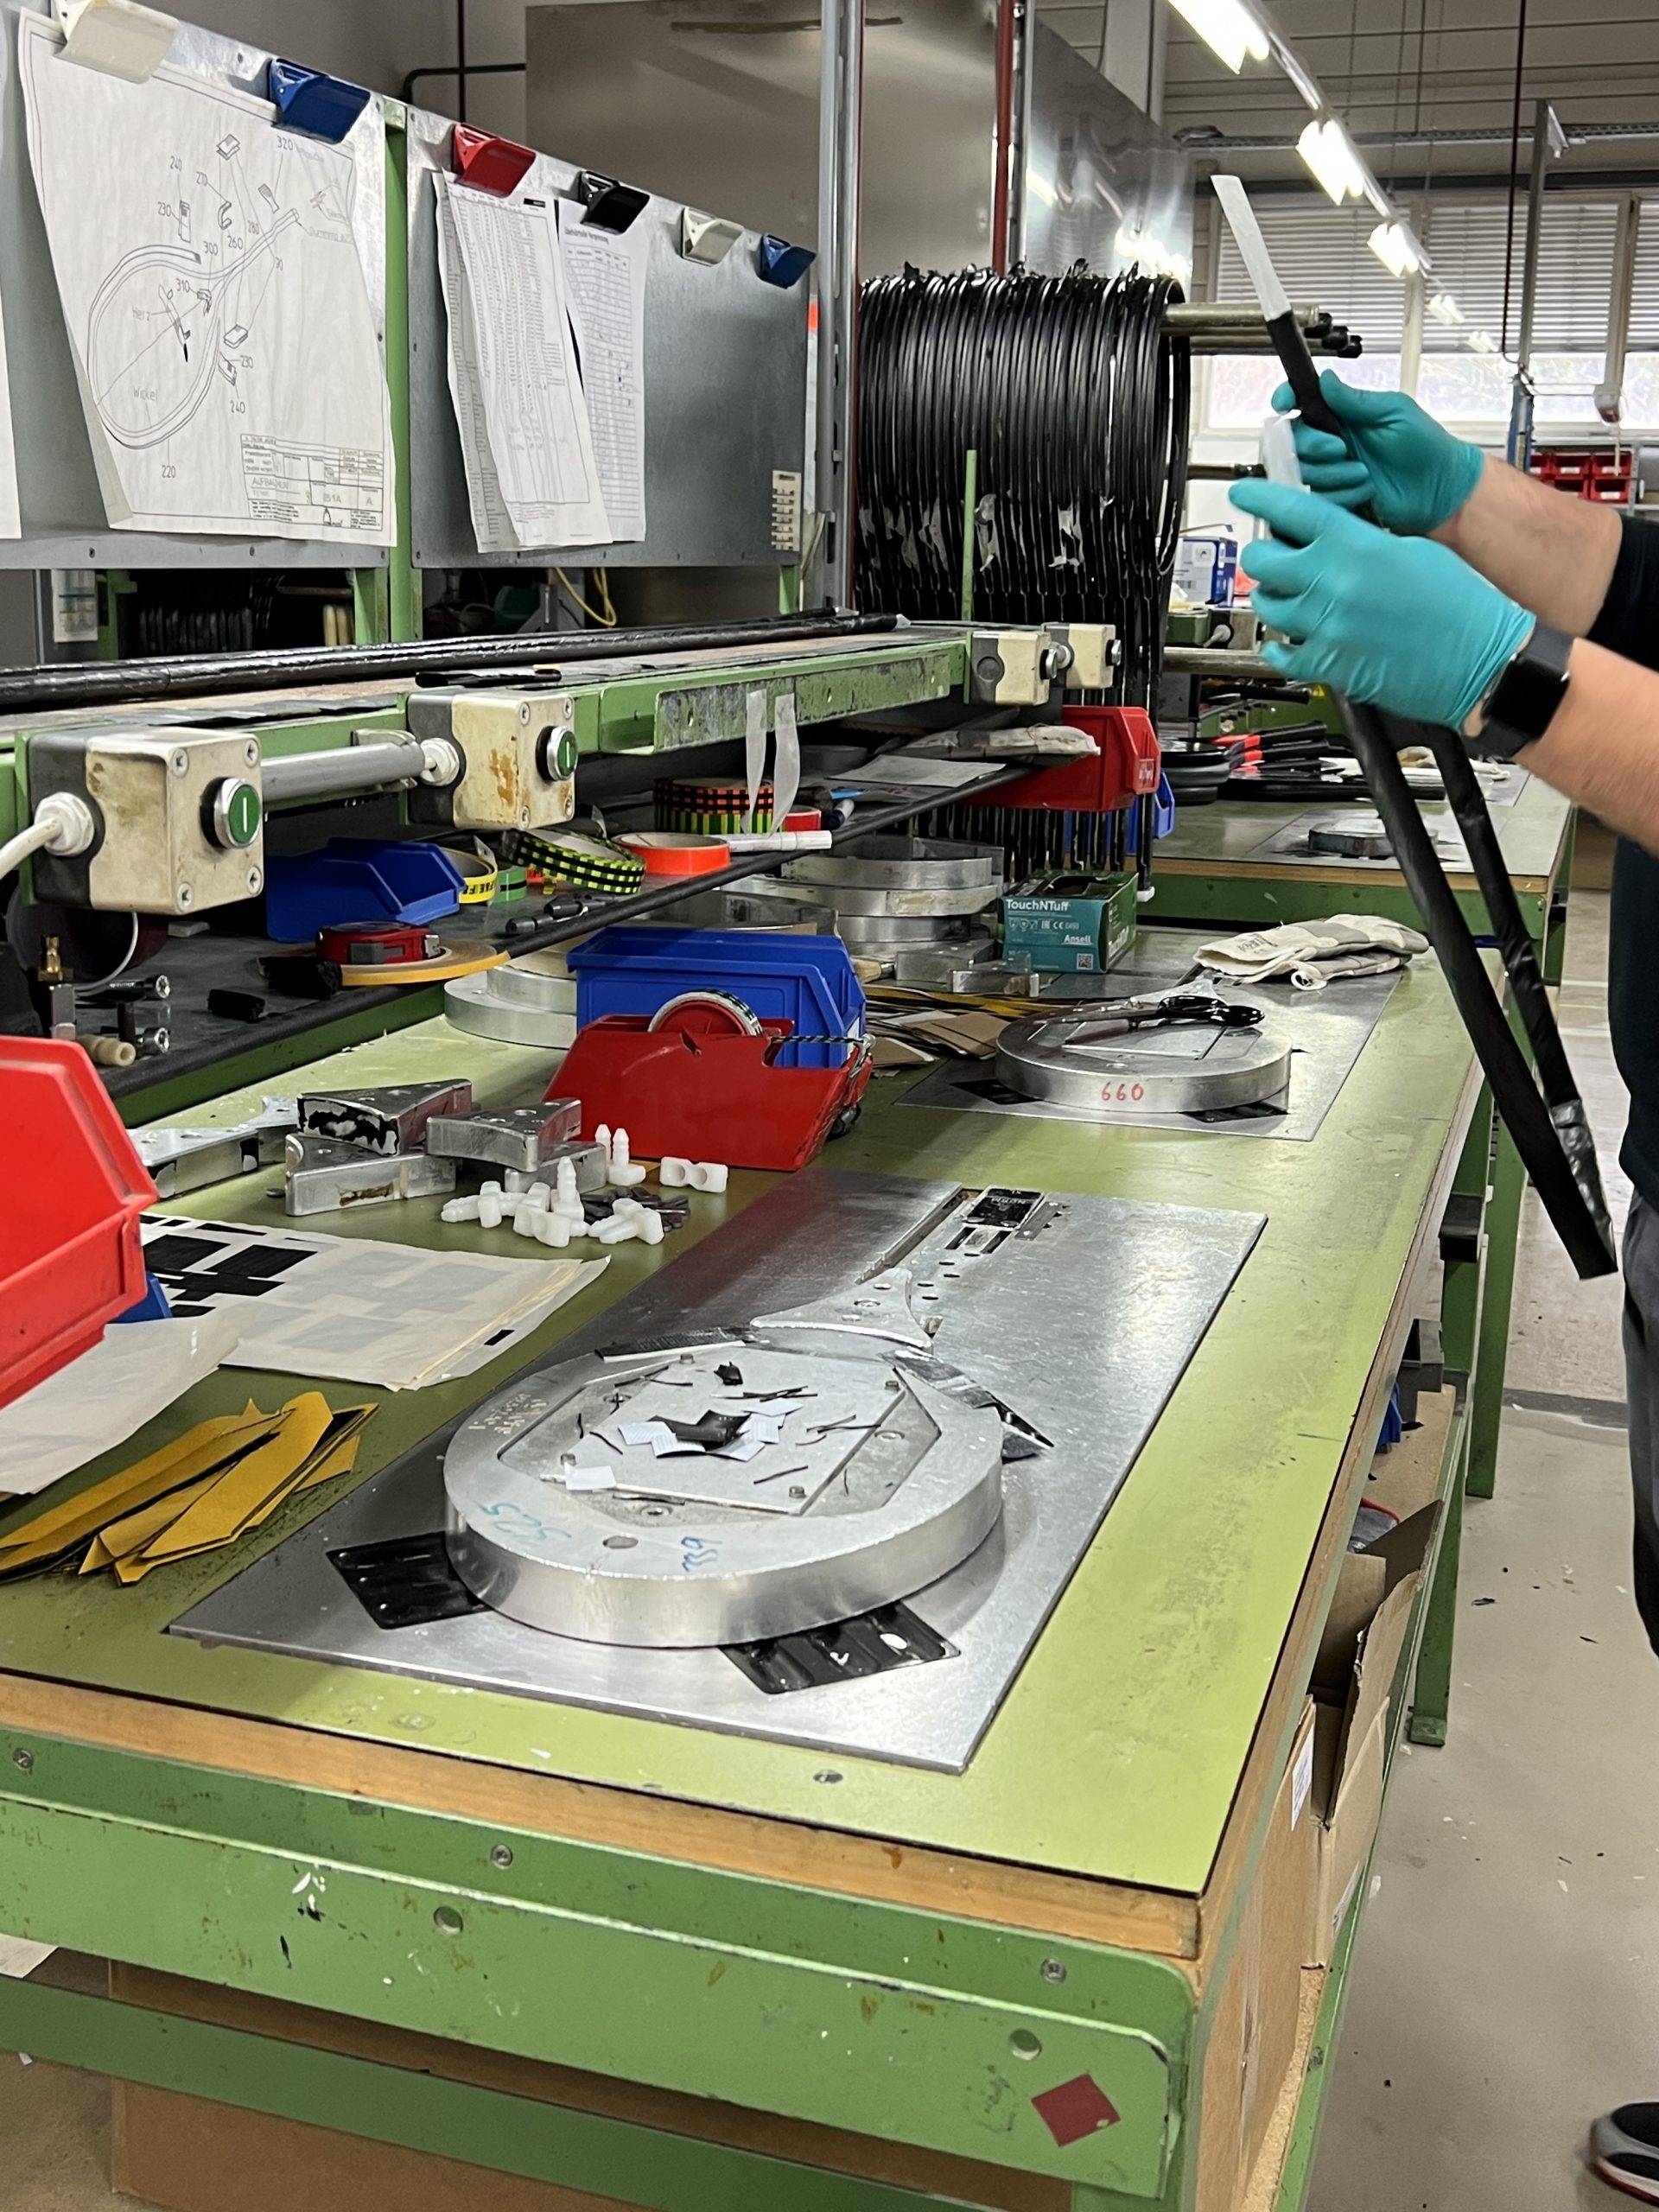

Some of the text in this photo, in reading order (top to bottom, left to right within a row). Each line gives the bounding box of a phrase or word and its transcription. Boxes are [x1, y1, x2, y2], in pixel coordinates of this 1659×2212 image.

[276, 136, 294, 151] 320
[169, 156, 182, 172] 240
[157, 201, 172, 217] 230
[204, 240, 218, 255] 300
[227, 235, 244, 250] 260
[176, 277, 190, 293] 310
[240, 354, 254, 369] 230
[230, 400, 246, 414] 240
[162, 464, 176, 479] 220
[1006, 899, 1069, 912] TouchNTuff
[1064, 934, 1091, 944] Ansell
[1102, 1081, 1144, 1102] 660
